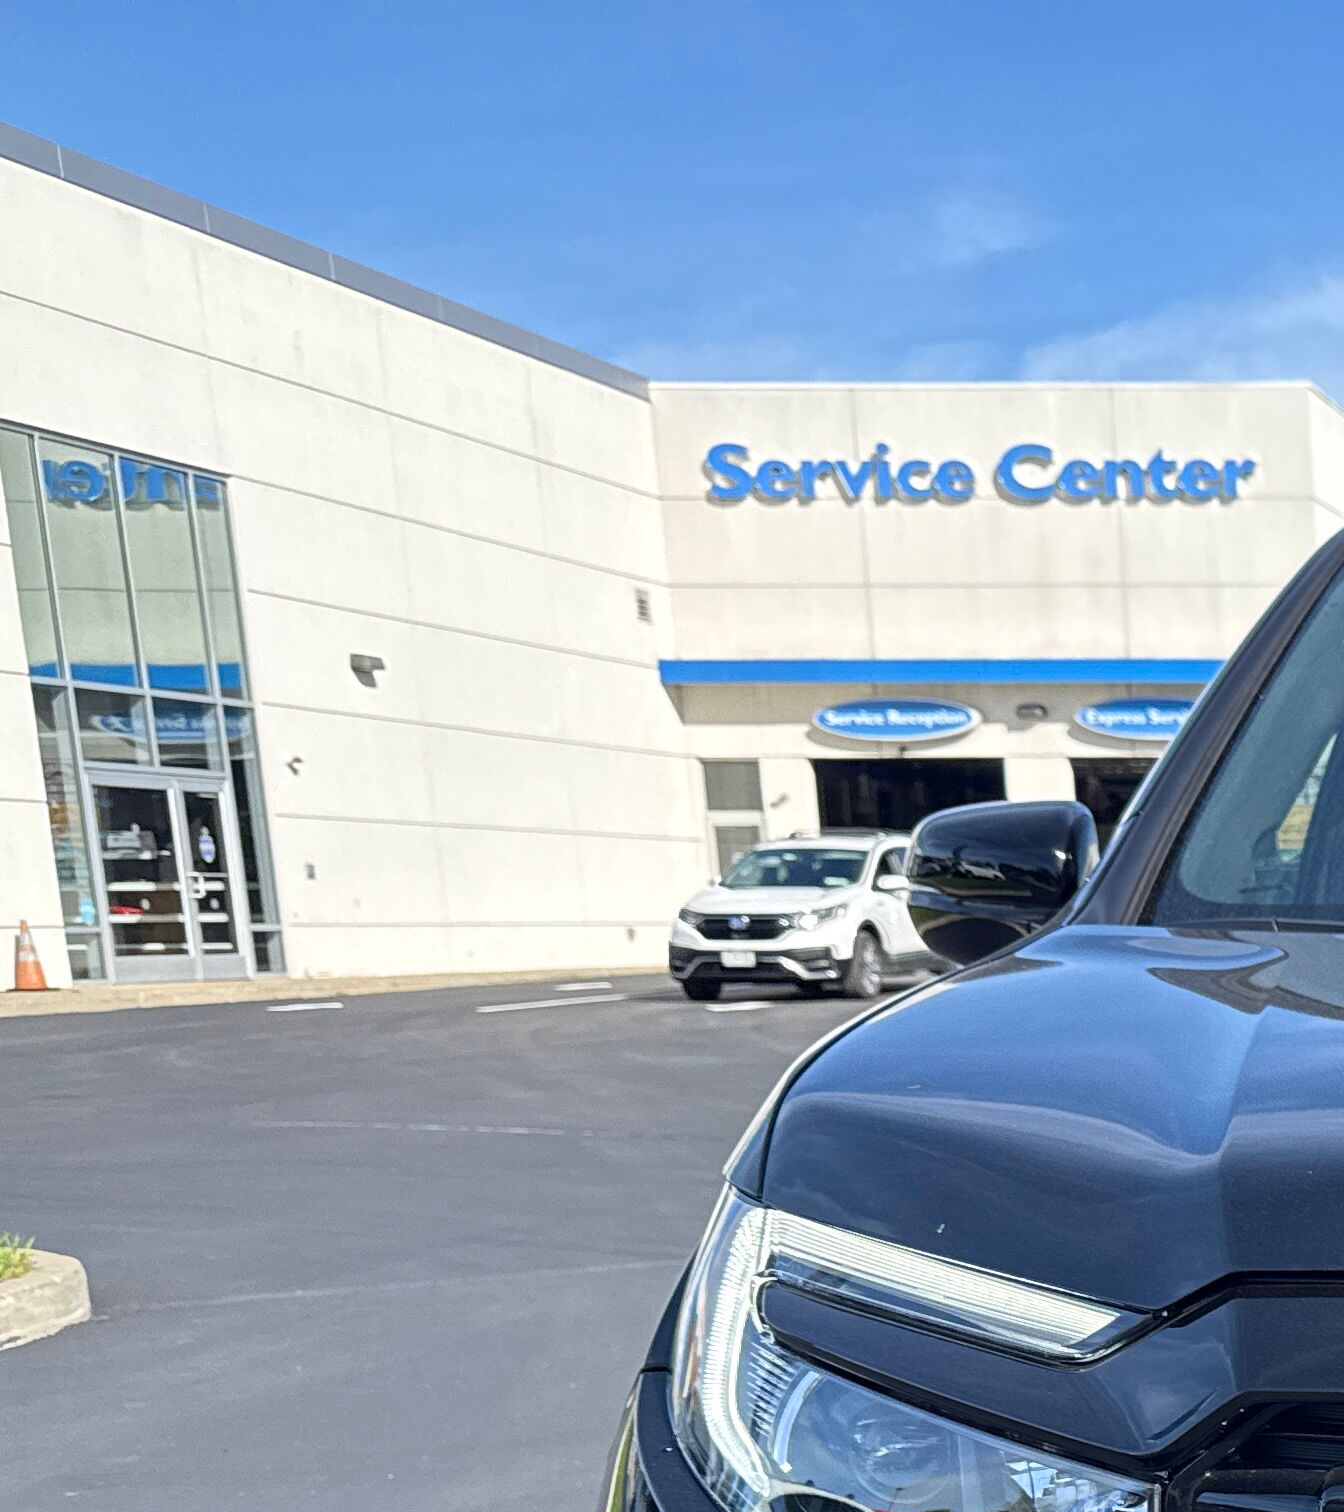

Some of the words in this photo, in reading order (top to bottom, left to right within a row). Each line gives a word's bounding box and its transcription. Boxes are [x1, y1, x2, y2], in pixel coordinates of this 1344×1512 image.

[704, 443, 975, 500] Service
[997, 443, 1257, 501] Center
[824, 708, 886, 727] Service
[886, 708, 971, 728] Reception
[1085, 707, 1147, 728] Express
